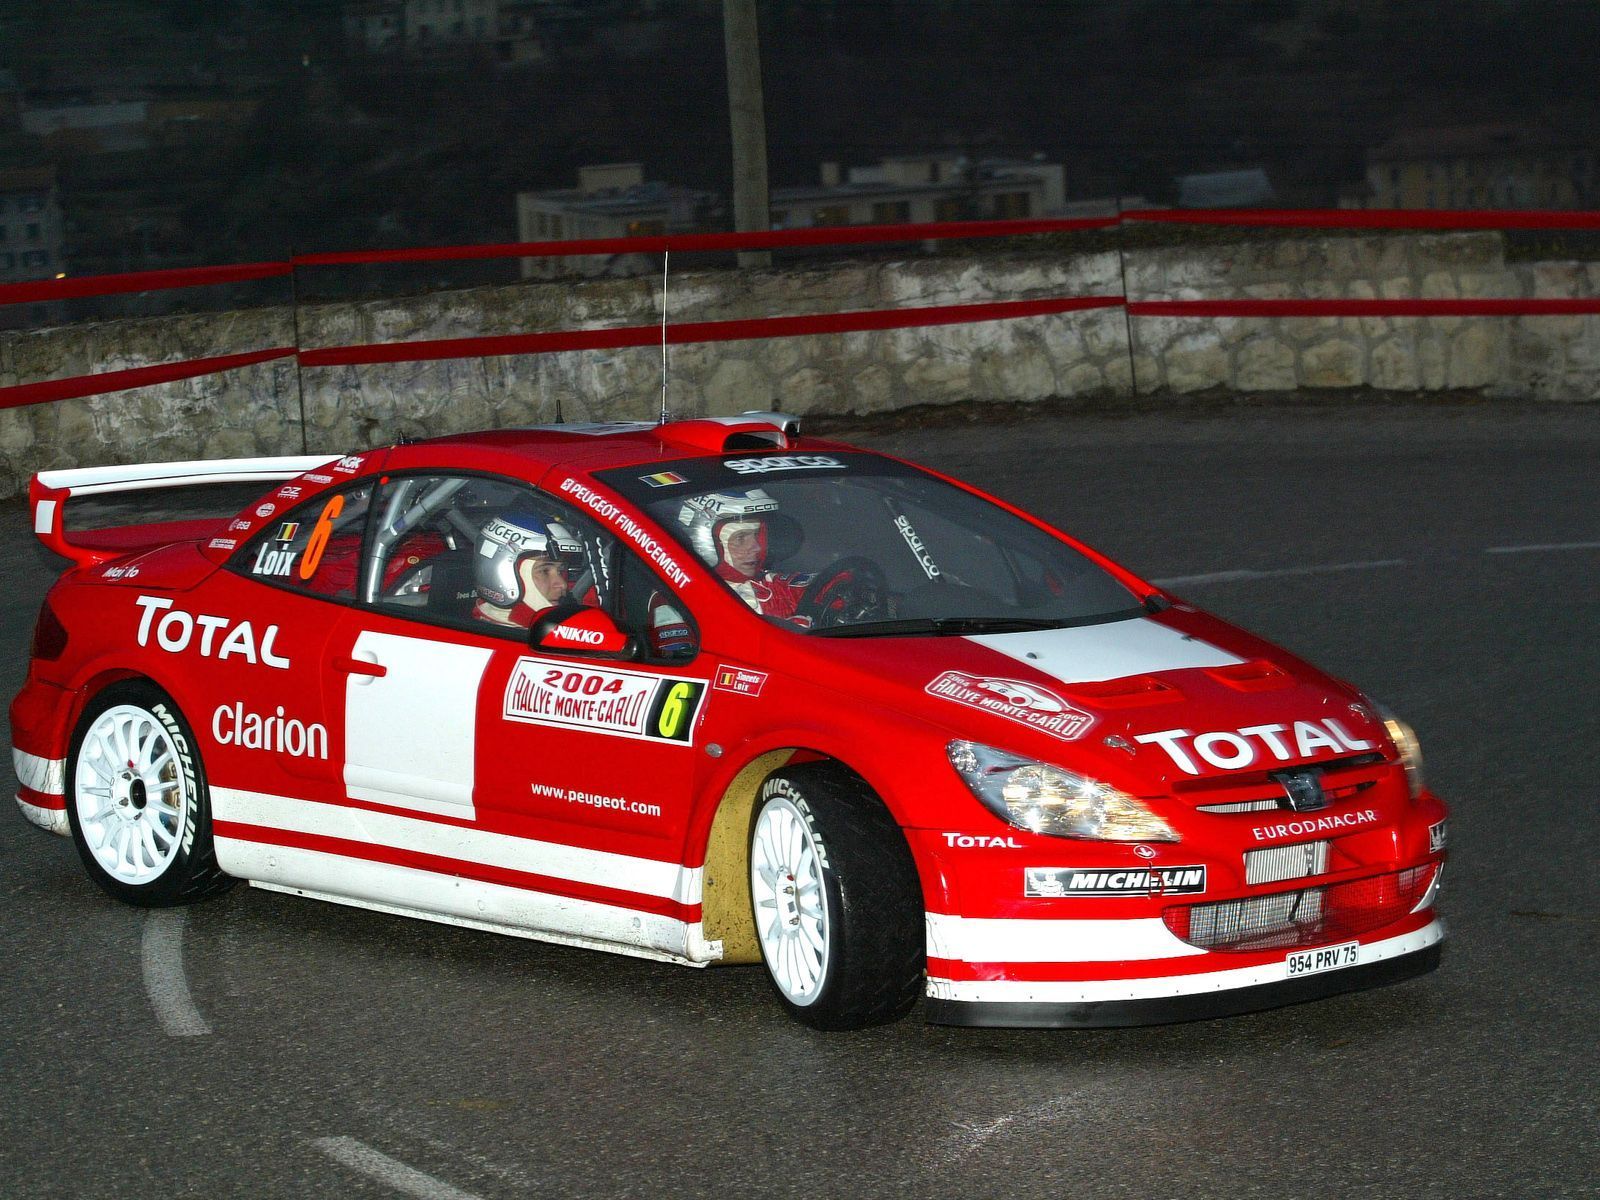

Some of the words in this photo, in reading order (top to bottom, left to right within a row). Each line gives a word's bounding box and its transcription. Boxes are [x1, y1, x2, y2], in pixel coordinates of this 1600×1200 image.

[336, 456, 365, 470] NGK
[723, 455, 848, 475] sparco
[280, 486, 302, 496] OZ
[300, 494, 344, 579] 6
[569, 484, 620, 520] PEUGEOT
[614, 514, 691, 589] FINANCEMENT
[894, 515, 940, 579] sparco
[253, 542, 297, 576] Loix
[136, 595, 290, 669] TOTAL
[554, 625, 605, 645] NIKKO
[512, 672, 553, 715] RALLYE
[554, 690, 647, 727] MONTE-CARLO
[543, 670, 625, 696] 2004
[734, 680, 750, 692] Loix
[658, 682, 691, 738] 6
[931, 678, 981, 703] RALLYE
[979, 697, 1082, 737] MONTE-CARLO
[1057, 713, 1087, 722] 2004
[212, 702, 328, 760] Clarion
[1133, 718, 1374, 775] TOTAL
[151, 703, 199, 856] MICHELIN
[531, 783, 661, 816] www.peugeot.com
[942, 832, 1023, 849] TOTAL
[1252, 809, 1377, 841] EURODATACAR
[1069, 868, 1203, 890] MICHELIN
[1289, 954, 1312, 974] 954
[1316, 948, 1341, 969] PRV
[1343, 945, 1358, 963] 75
